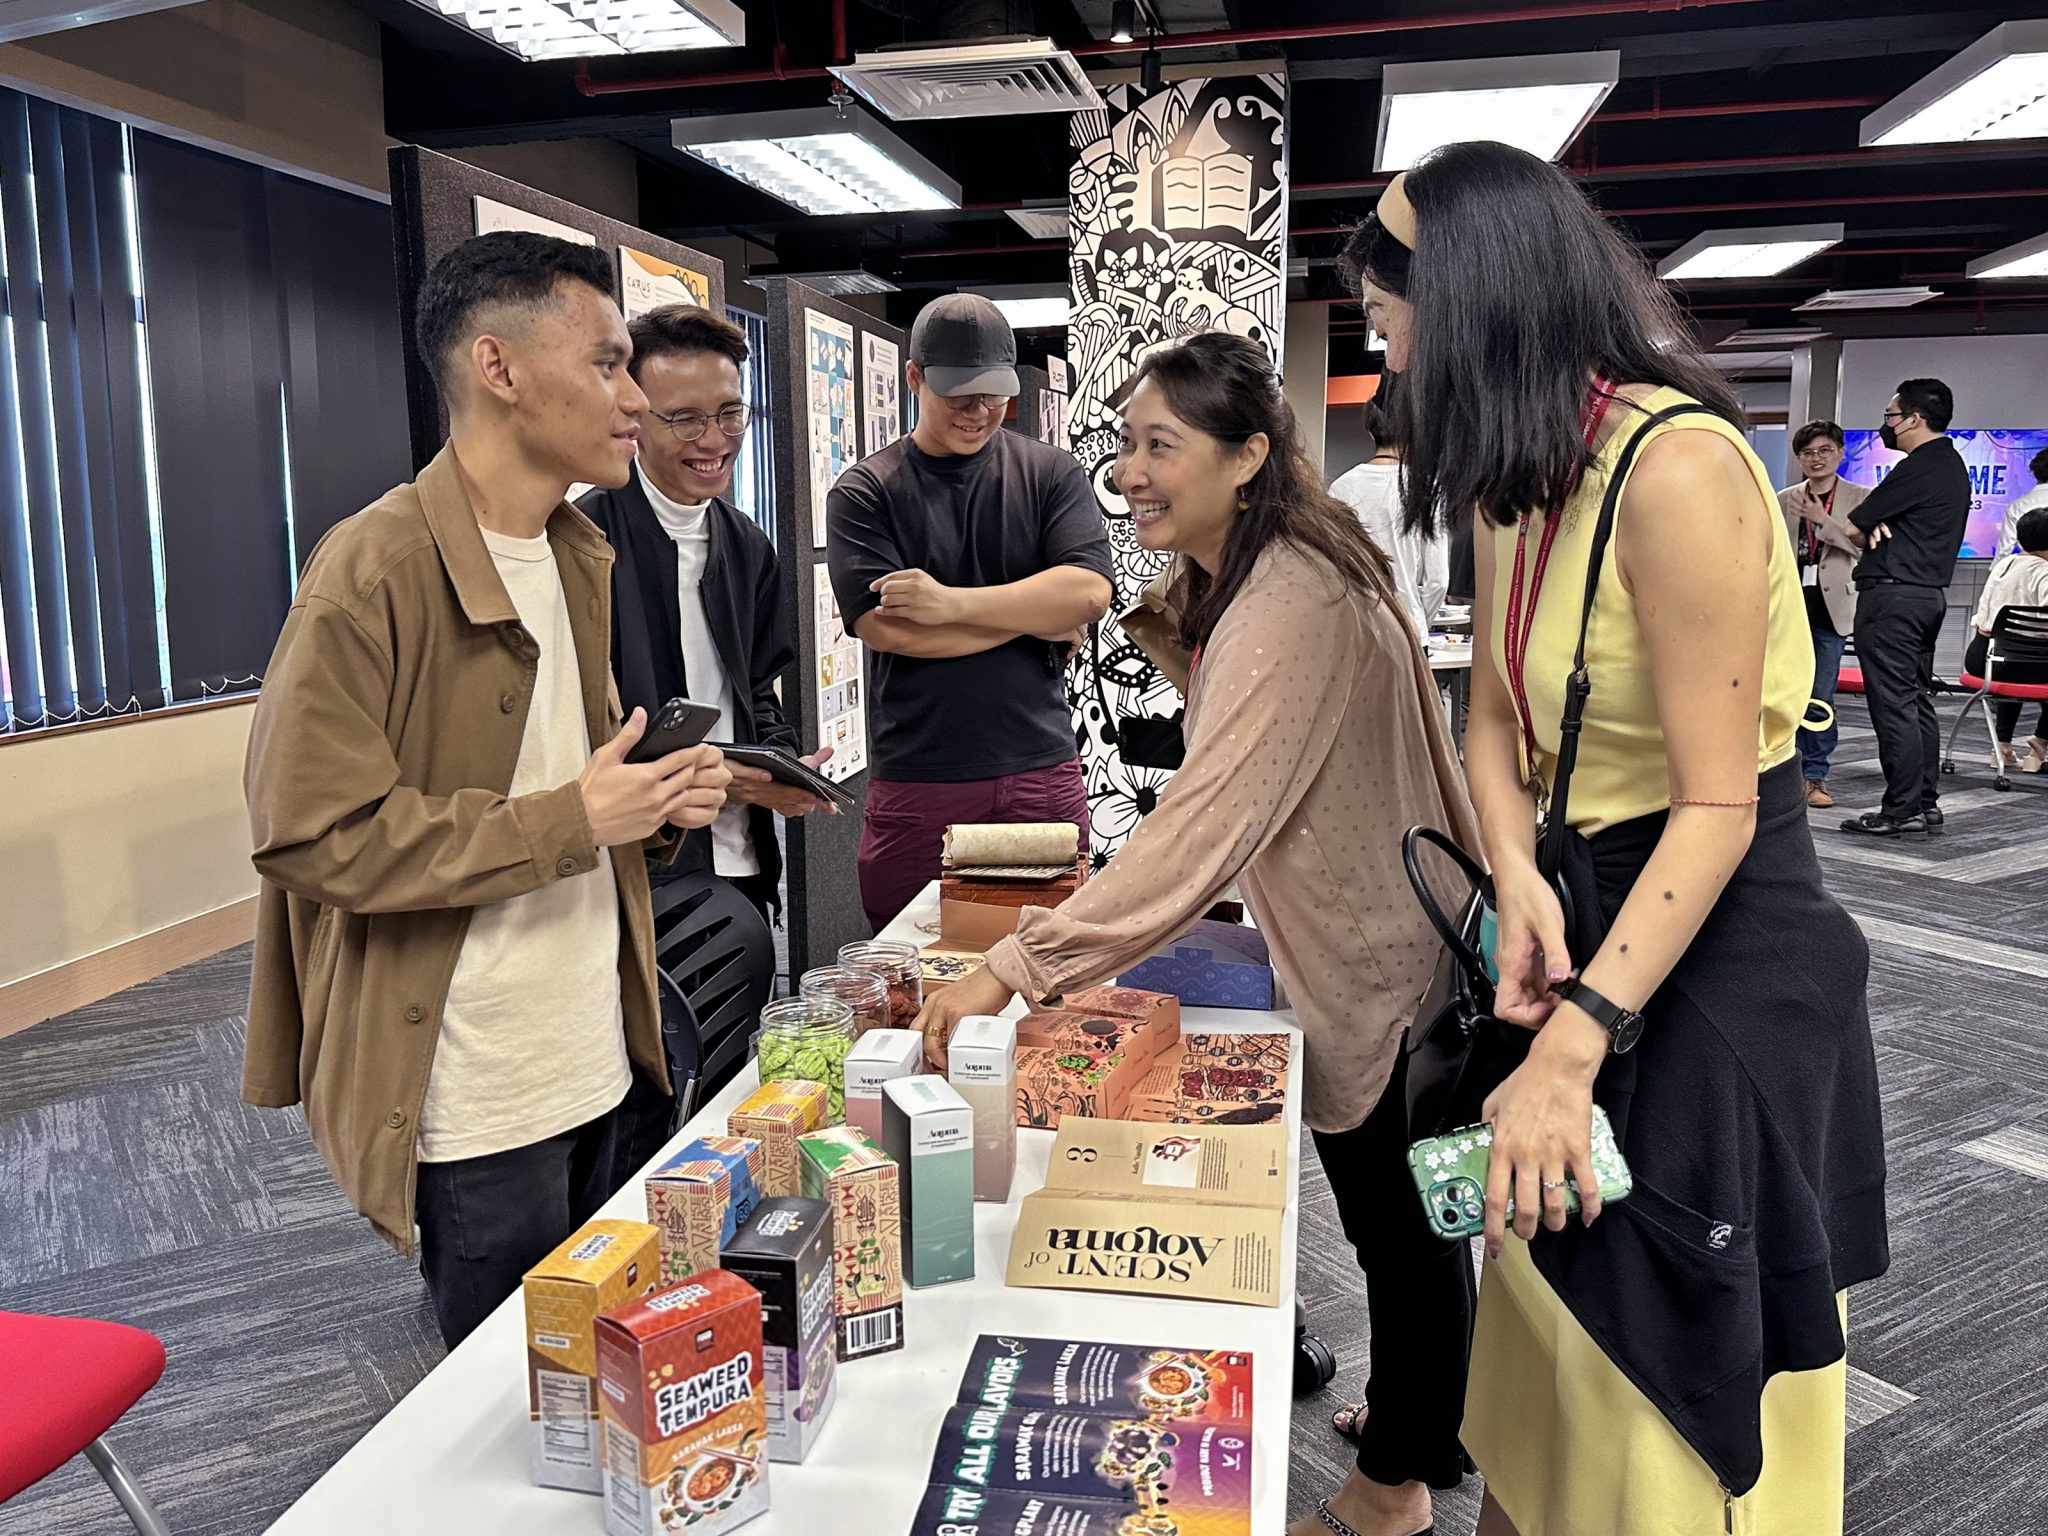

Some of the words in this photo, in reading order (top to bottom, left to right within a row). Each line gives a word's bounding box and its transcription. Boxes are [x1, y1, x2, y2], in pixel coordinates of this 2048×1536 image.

[1510, 584, 1520, 616] University
[1507, 623, 1516, 660] Technology
[1066, 1147, 1097, 1163] 3
[572, 1234, 605, 1260] SEAWEED
[1024, 1251, 1050, 1269] of
[1046, 1226, 1225, 1267] Aoroma
[1058, 1251, 1192, 1283] SCENT
[648, 1284, 701, 1306] SEAWEED
[655, 1289, 708, 1310] TEMPURA
[803, 1260, 833, 1316] SEAWEED
[1056, 1344, 1080, 1365] LAKSA
[658, 1355, 749, 1412] SEAWEED
[981, 1357, 1019, 1410] LAVORS
[1053, 1365, 1070, 1406] SARAWAK
[659, 1379, 751, 1434] TEMPURA
[671, 1431, 714, 1462] SARAWAK
[715, 1422, 744, 1439] LAKSA
[967, 1409, 1003, 1440] OUR
[957, 1444, 992, 1485] ALL
[1014, 1424, 1034, 1481] SARAWAK
[1199, 1463, 1214, 1496] PROUDLY
[946, 1487, 982, 1519] TRY
[1014, 1498, 1045, 1536] GPLANT
